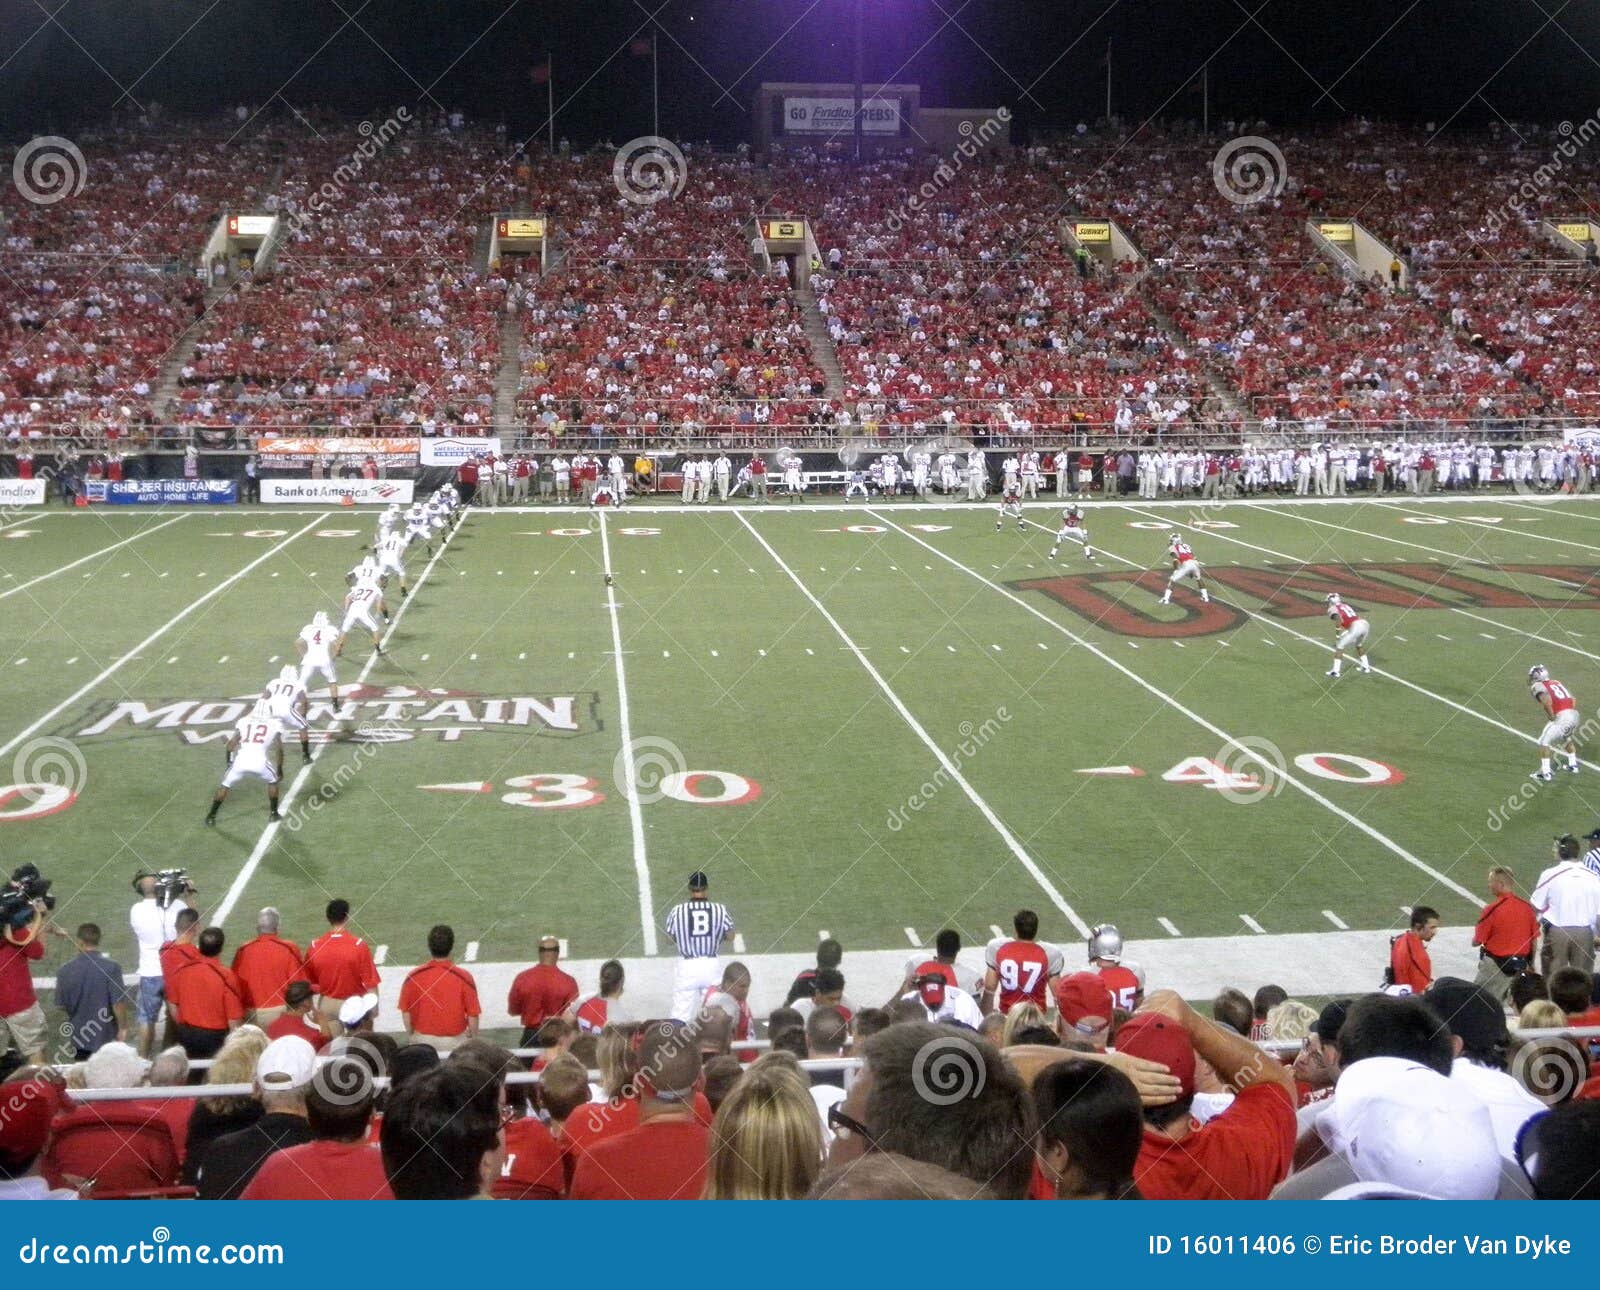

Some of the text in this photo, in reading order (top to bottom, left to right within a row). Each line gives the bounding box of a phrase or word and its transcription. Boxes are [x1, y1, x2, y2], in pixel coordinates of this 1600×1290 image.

[790, 107, 807, 121] GO
[862, 108, 895, 121] REBS!
[500, 223, 506, 233] 6
[137, 493, 159, 501] AUTO
[192, 492, 209, 500] LIFE
[274, 486, 368, 497] Bank of America
[384, 540, 397, 551] 41
[356, 588, 374, 602] 27
[312, 630, 322, 645] 4
[274, 684, 294, 697] 10
[76, 697, 581, 737] MONTAIN
[241, 723, 268, 745] 12
[501, 770, 754, 811] 30
[691, 909, 710, 936] B
[1000, 958, 1043, 994] 97
[1108, 986, 1137, 1013] 5
